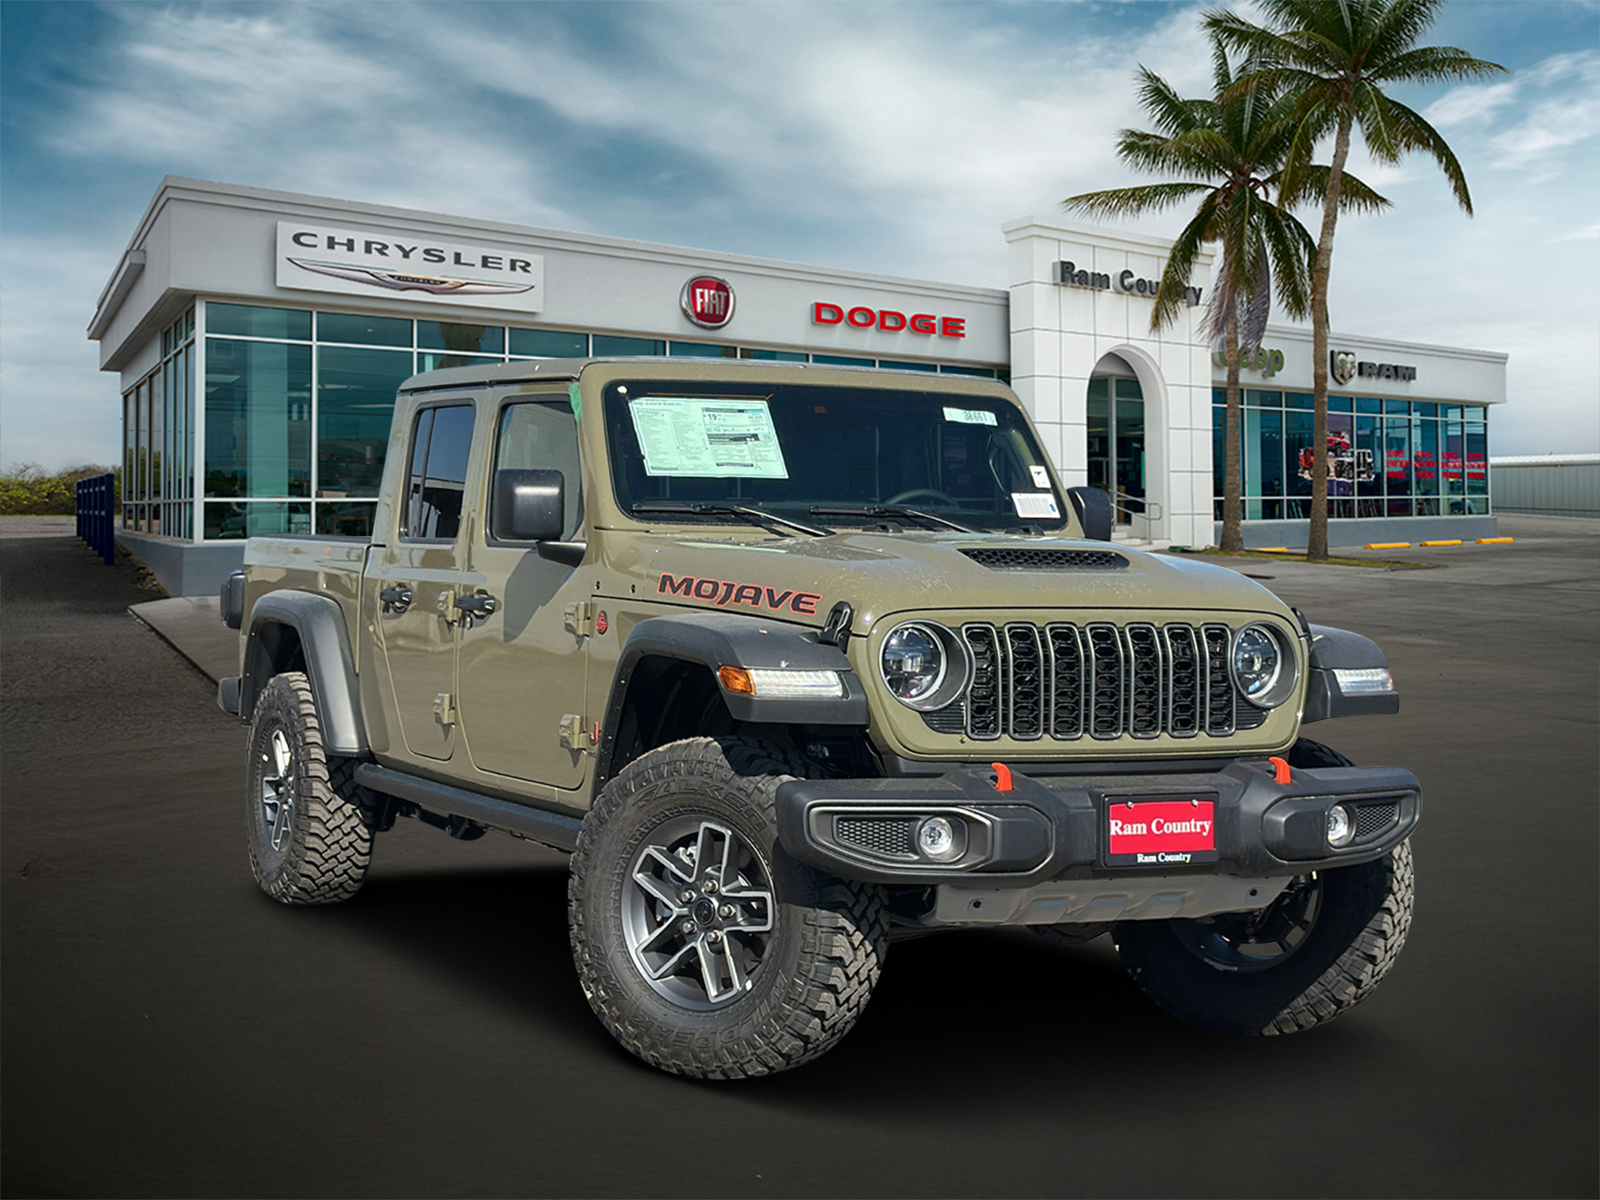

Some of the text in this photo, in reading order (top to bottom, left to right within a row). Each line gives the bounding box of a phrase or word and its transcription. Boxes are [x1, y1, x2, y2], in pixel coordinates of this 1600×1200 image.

[292, 232, 532, 273] CHRYSLER
[1053, 260, 1203, 307] Ram Coury
[695, 287, 727, 316] FIAT
[812, 301, 966, 338] DODGE
[1358, 361, 1417, 381] RAM
[657, 572, 823, 617] MOJAVE
[1109, 818, 1211, 836] Ram Country
[1137, 852, 1191, 863] Ram Country
